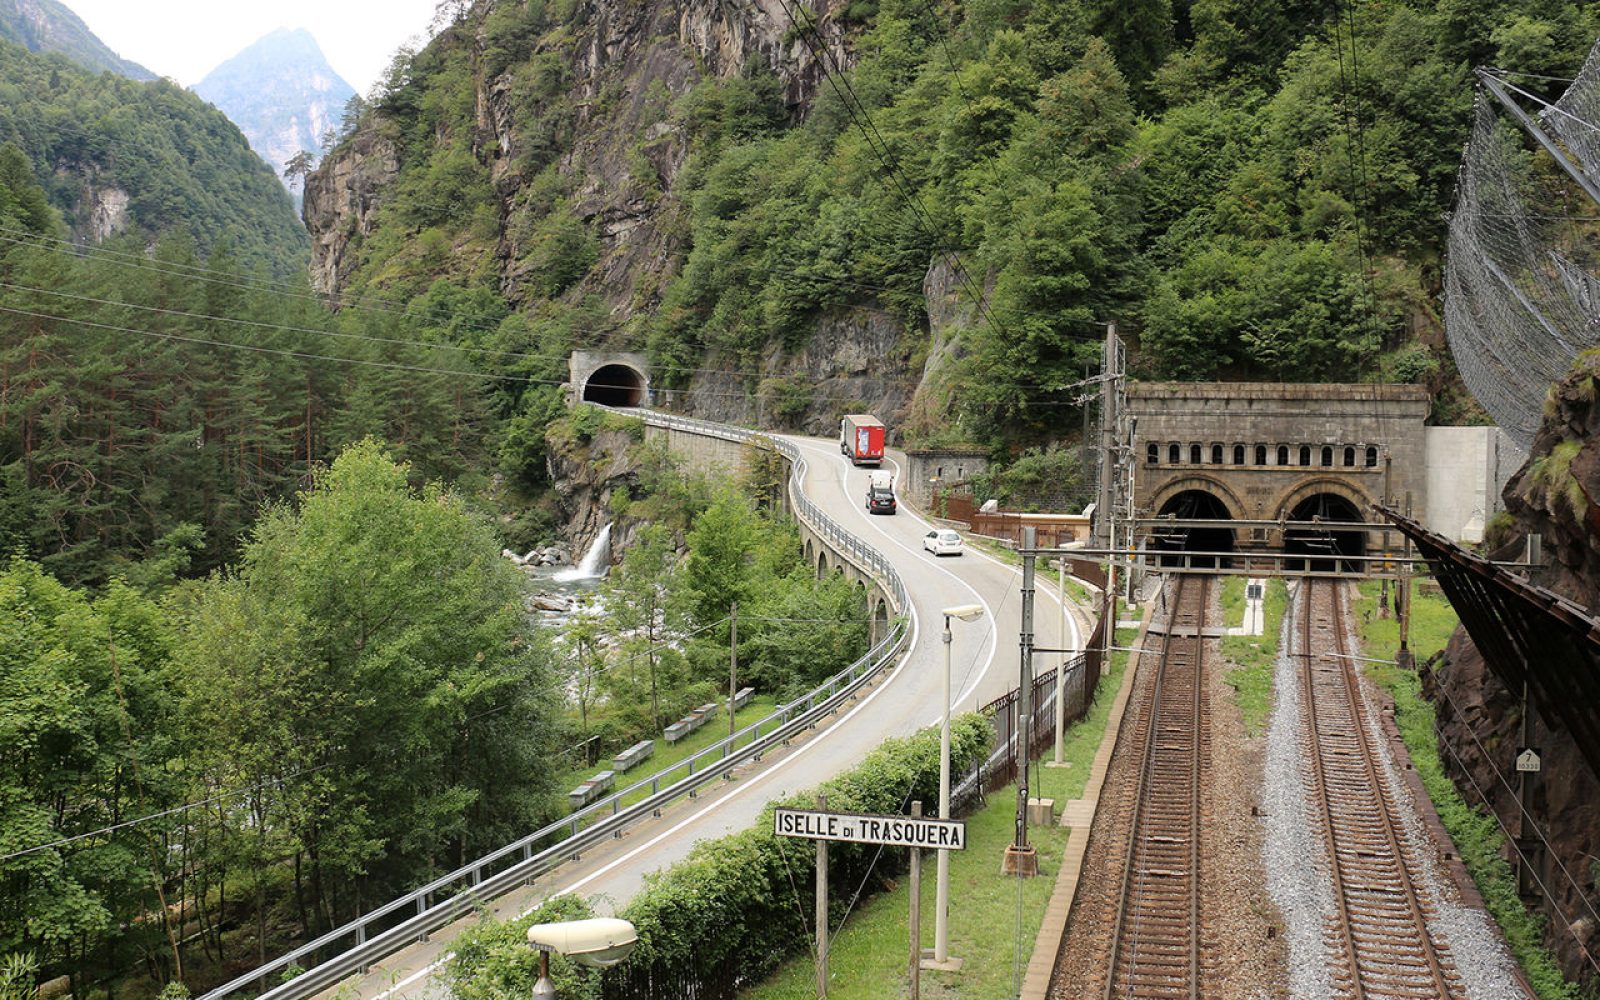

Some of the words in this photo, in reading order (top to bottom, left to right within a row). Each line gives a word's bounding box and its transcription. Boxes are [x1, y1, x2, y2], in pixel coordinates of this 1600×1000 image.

[1526, 753, 1532, 762] 7
[778, 813, 838, 836] ISELLE
[843, 827, 854, 838] DI
[860, 819, 960, 846] TRASQUERA
